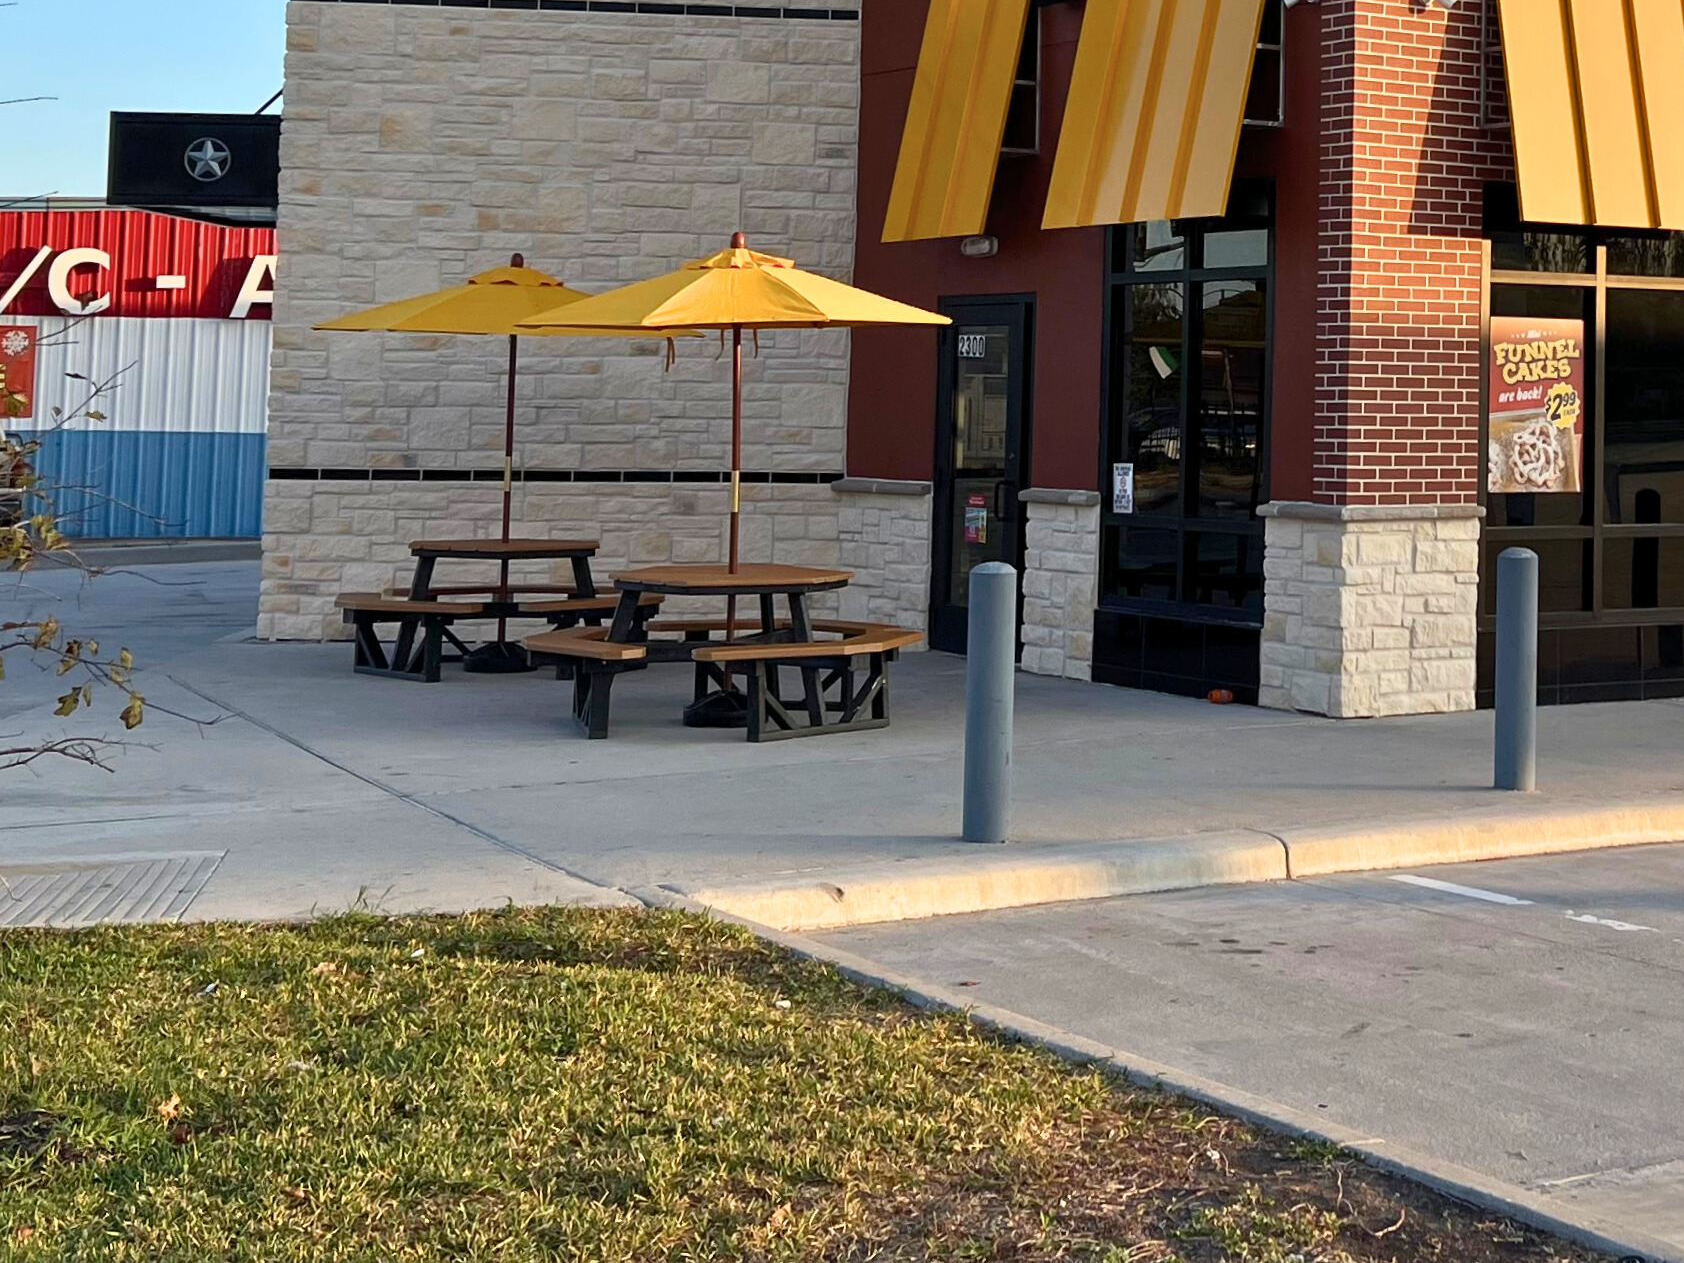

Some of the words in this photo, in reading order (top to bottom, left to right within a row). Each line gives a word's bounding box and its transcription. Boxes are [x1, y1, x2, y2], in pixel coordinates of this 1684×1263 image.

[960, 336, 986, 356] 2300
[1494, 339, 1580, 365] FUNNEL
[1503, 358, 1571, 384] CAKES
[1499, 393, 1515, 403] are
[1517, 385, 1543, 401] back!
